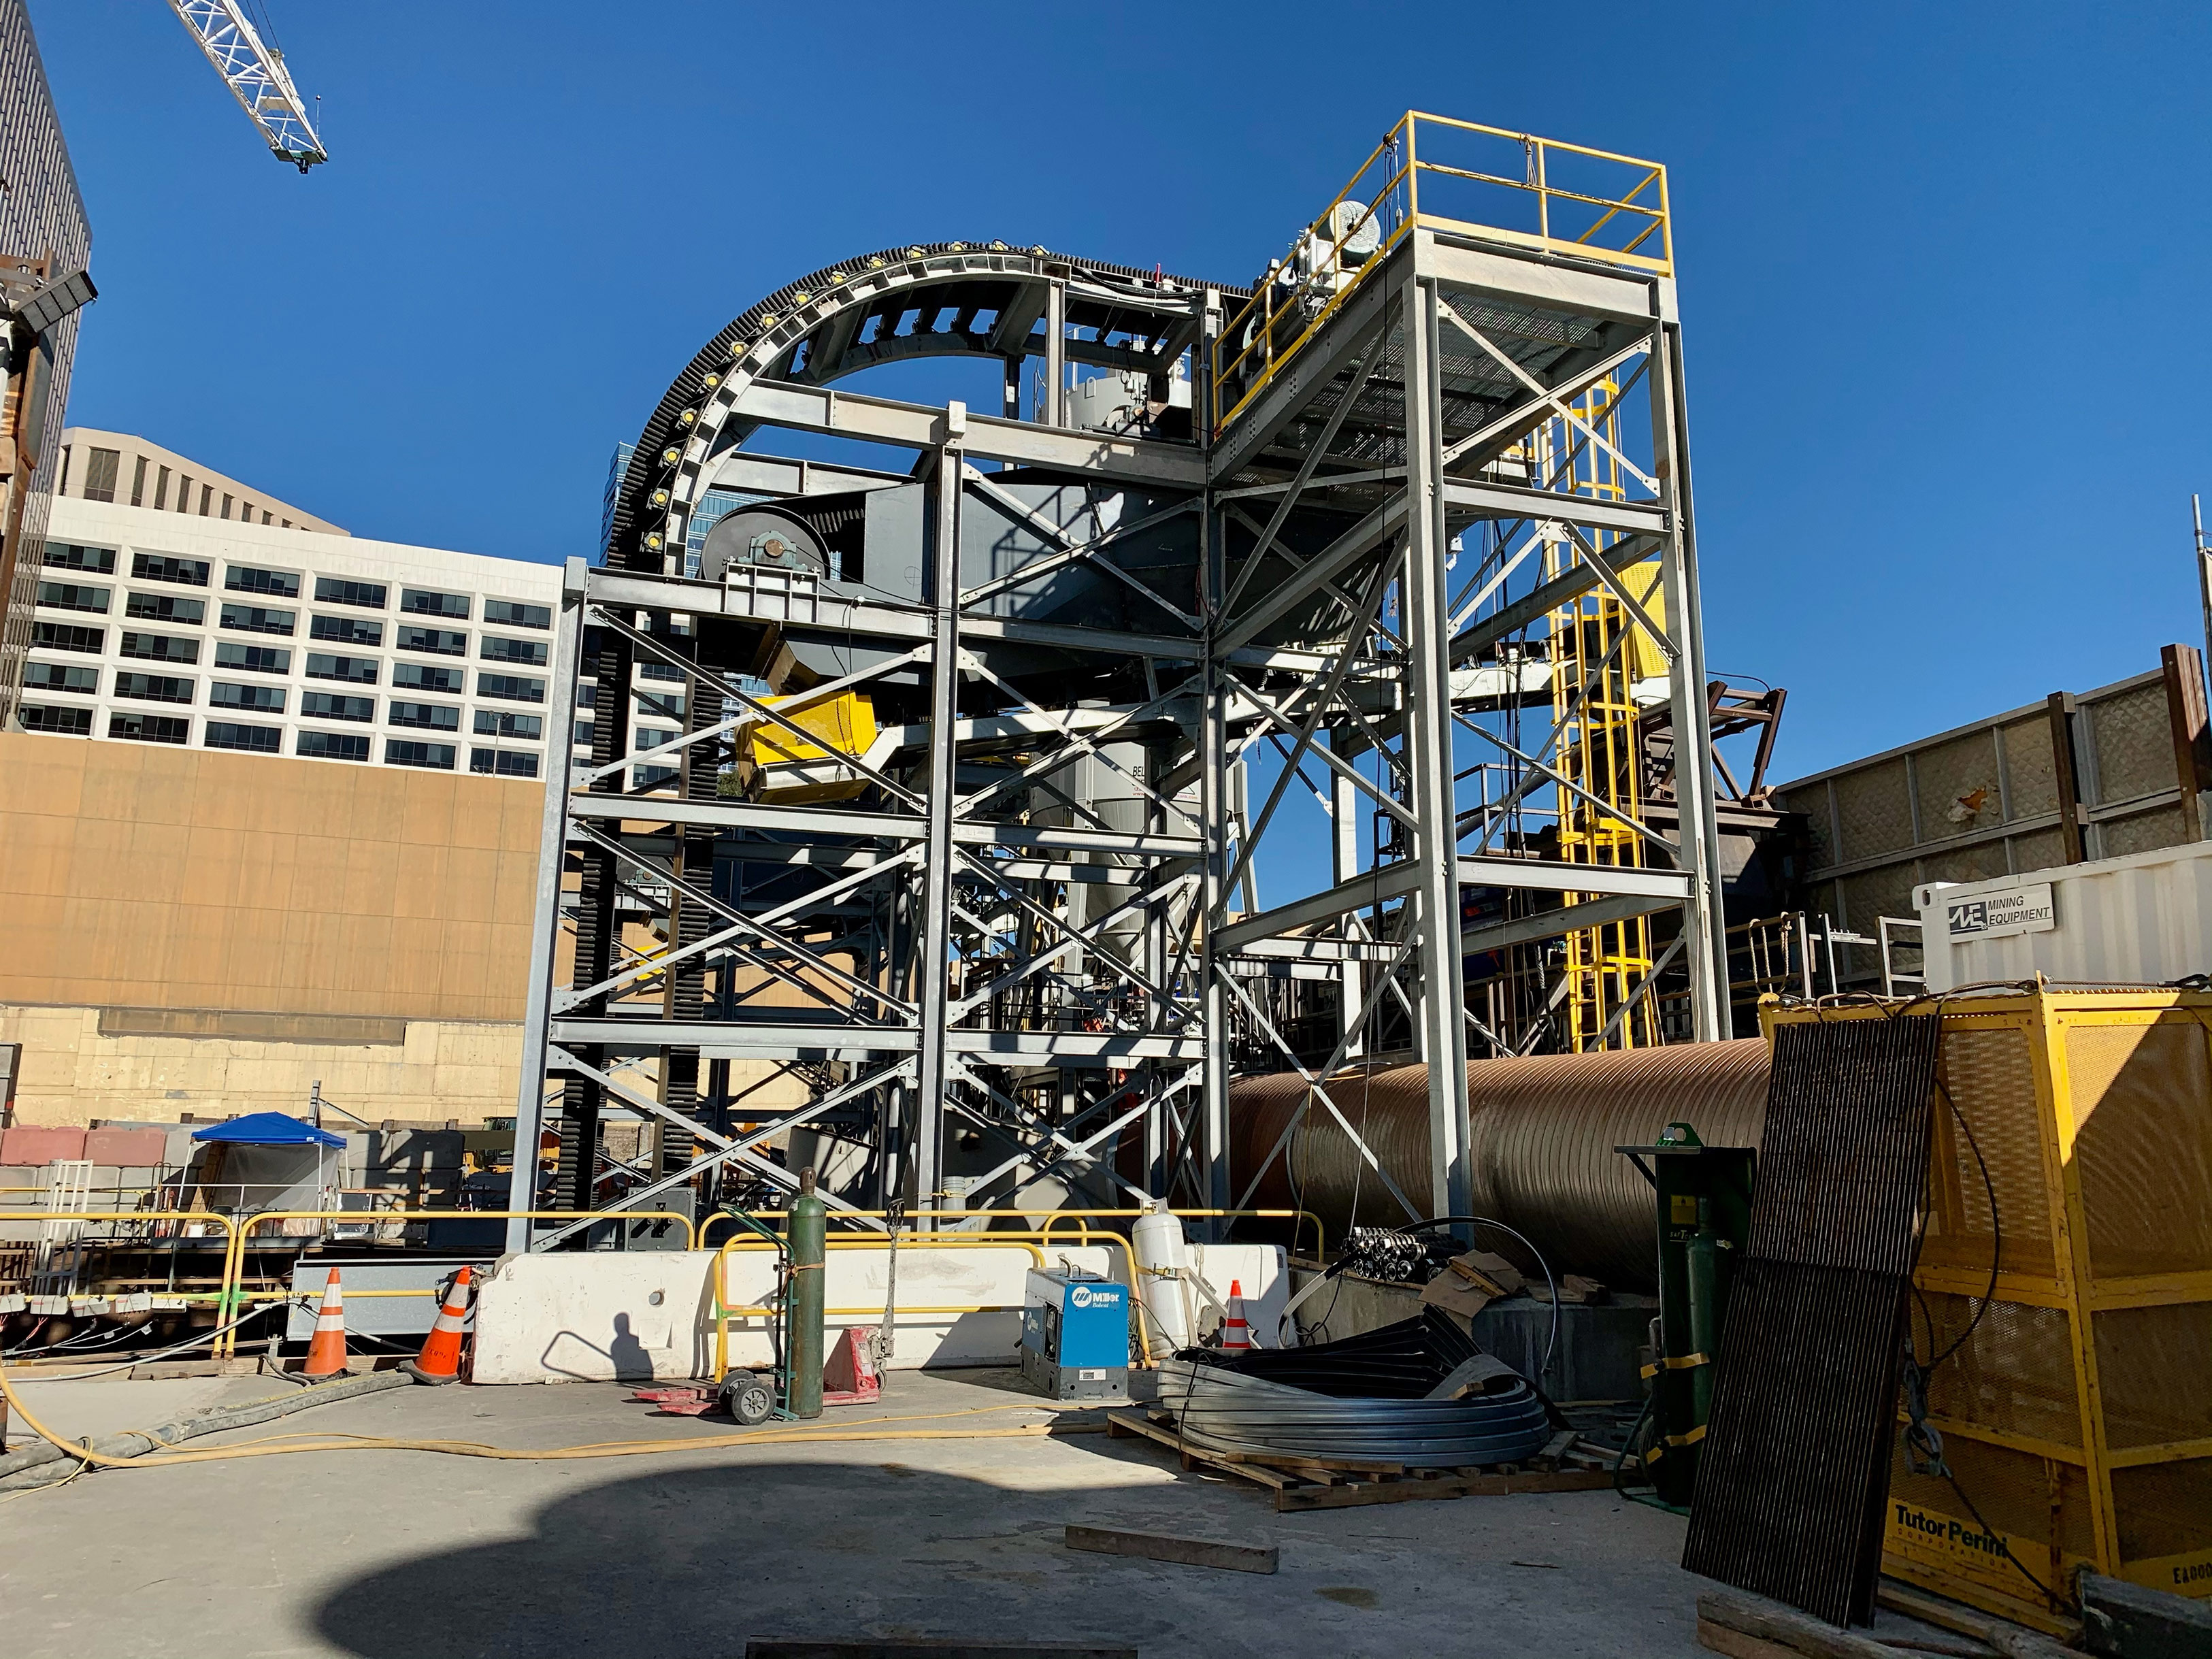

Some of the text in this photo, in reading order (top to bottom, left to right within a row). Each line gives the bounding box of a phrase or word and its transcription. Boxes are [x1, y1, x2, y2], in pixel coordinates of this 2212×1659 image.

[1987, 896, 2024, 910] MINING
[1989, 907, 2050, 925] EQUIPMENT
[1093, 1292, 1120, 1302] Miller
[1895, 1505, 1947, 1537] Tutor
[1898, 1528, 2007, 1570] CORPORATION
